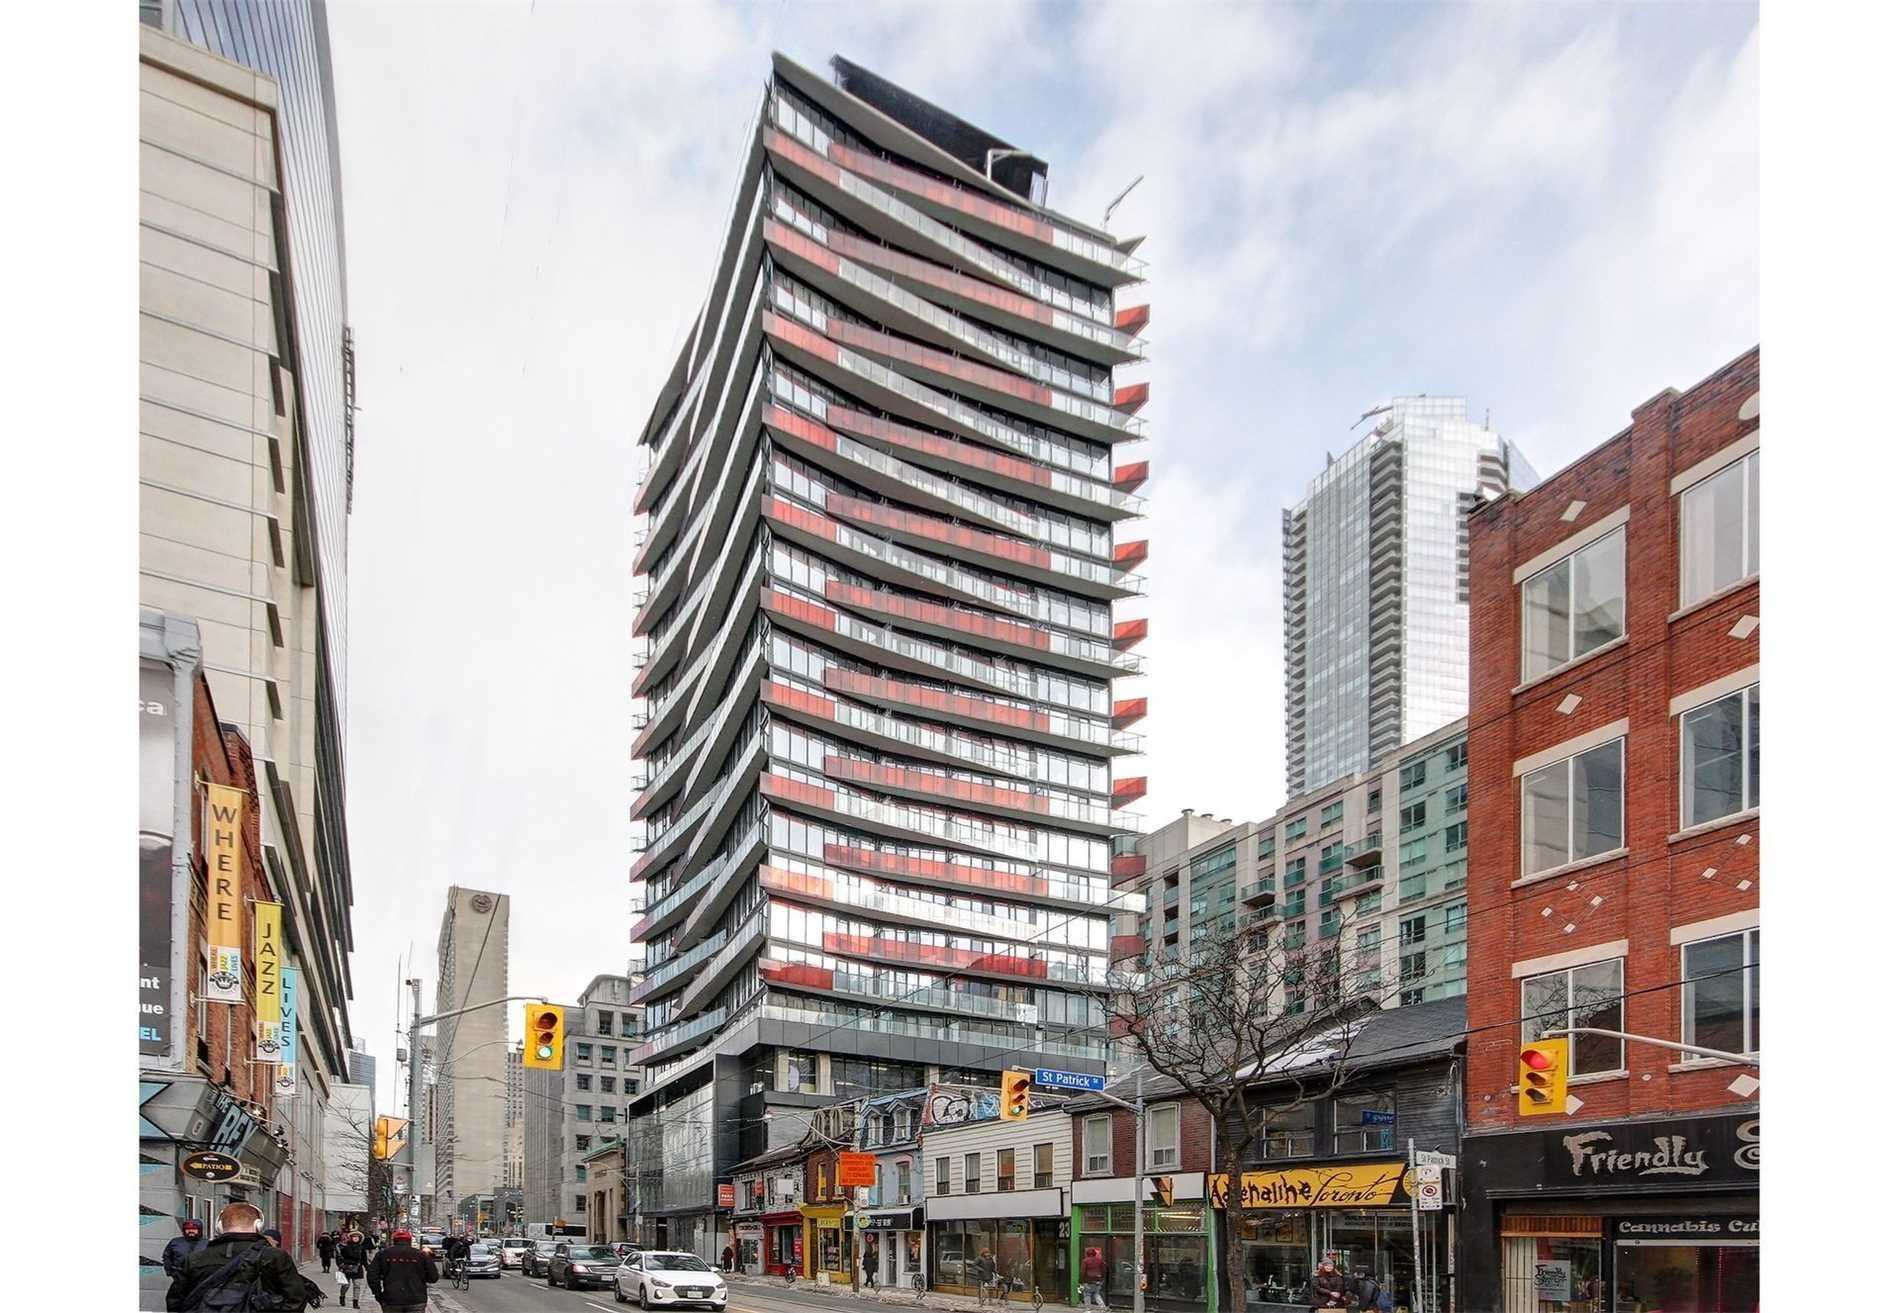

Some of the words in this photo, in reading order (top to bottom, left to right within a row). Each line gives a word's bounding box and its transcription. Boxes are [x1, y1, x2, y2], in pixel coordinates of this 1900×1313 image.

[212, 804, 237, 920] WHERE
[260, 923, 276, 995] JAZZ
[281, 978, 292, 1047] LIVES
[1042, 1072, 1053, 1083] St
[1056, 1073, 1090, 1087] Patrick
[1562, 1131, 1710, 1176] Friendly
[1210, 1175, 1312, 1208] Adenaline
[1309, 1171, 1401, 1207] Toronto
[1618, 1219, 1721, 1234] Cannabis
